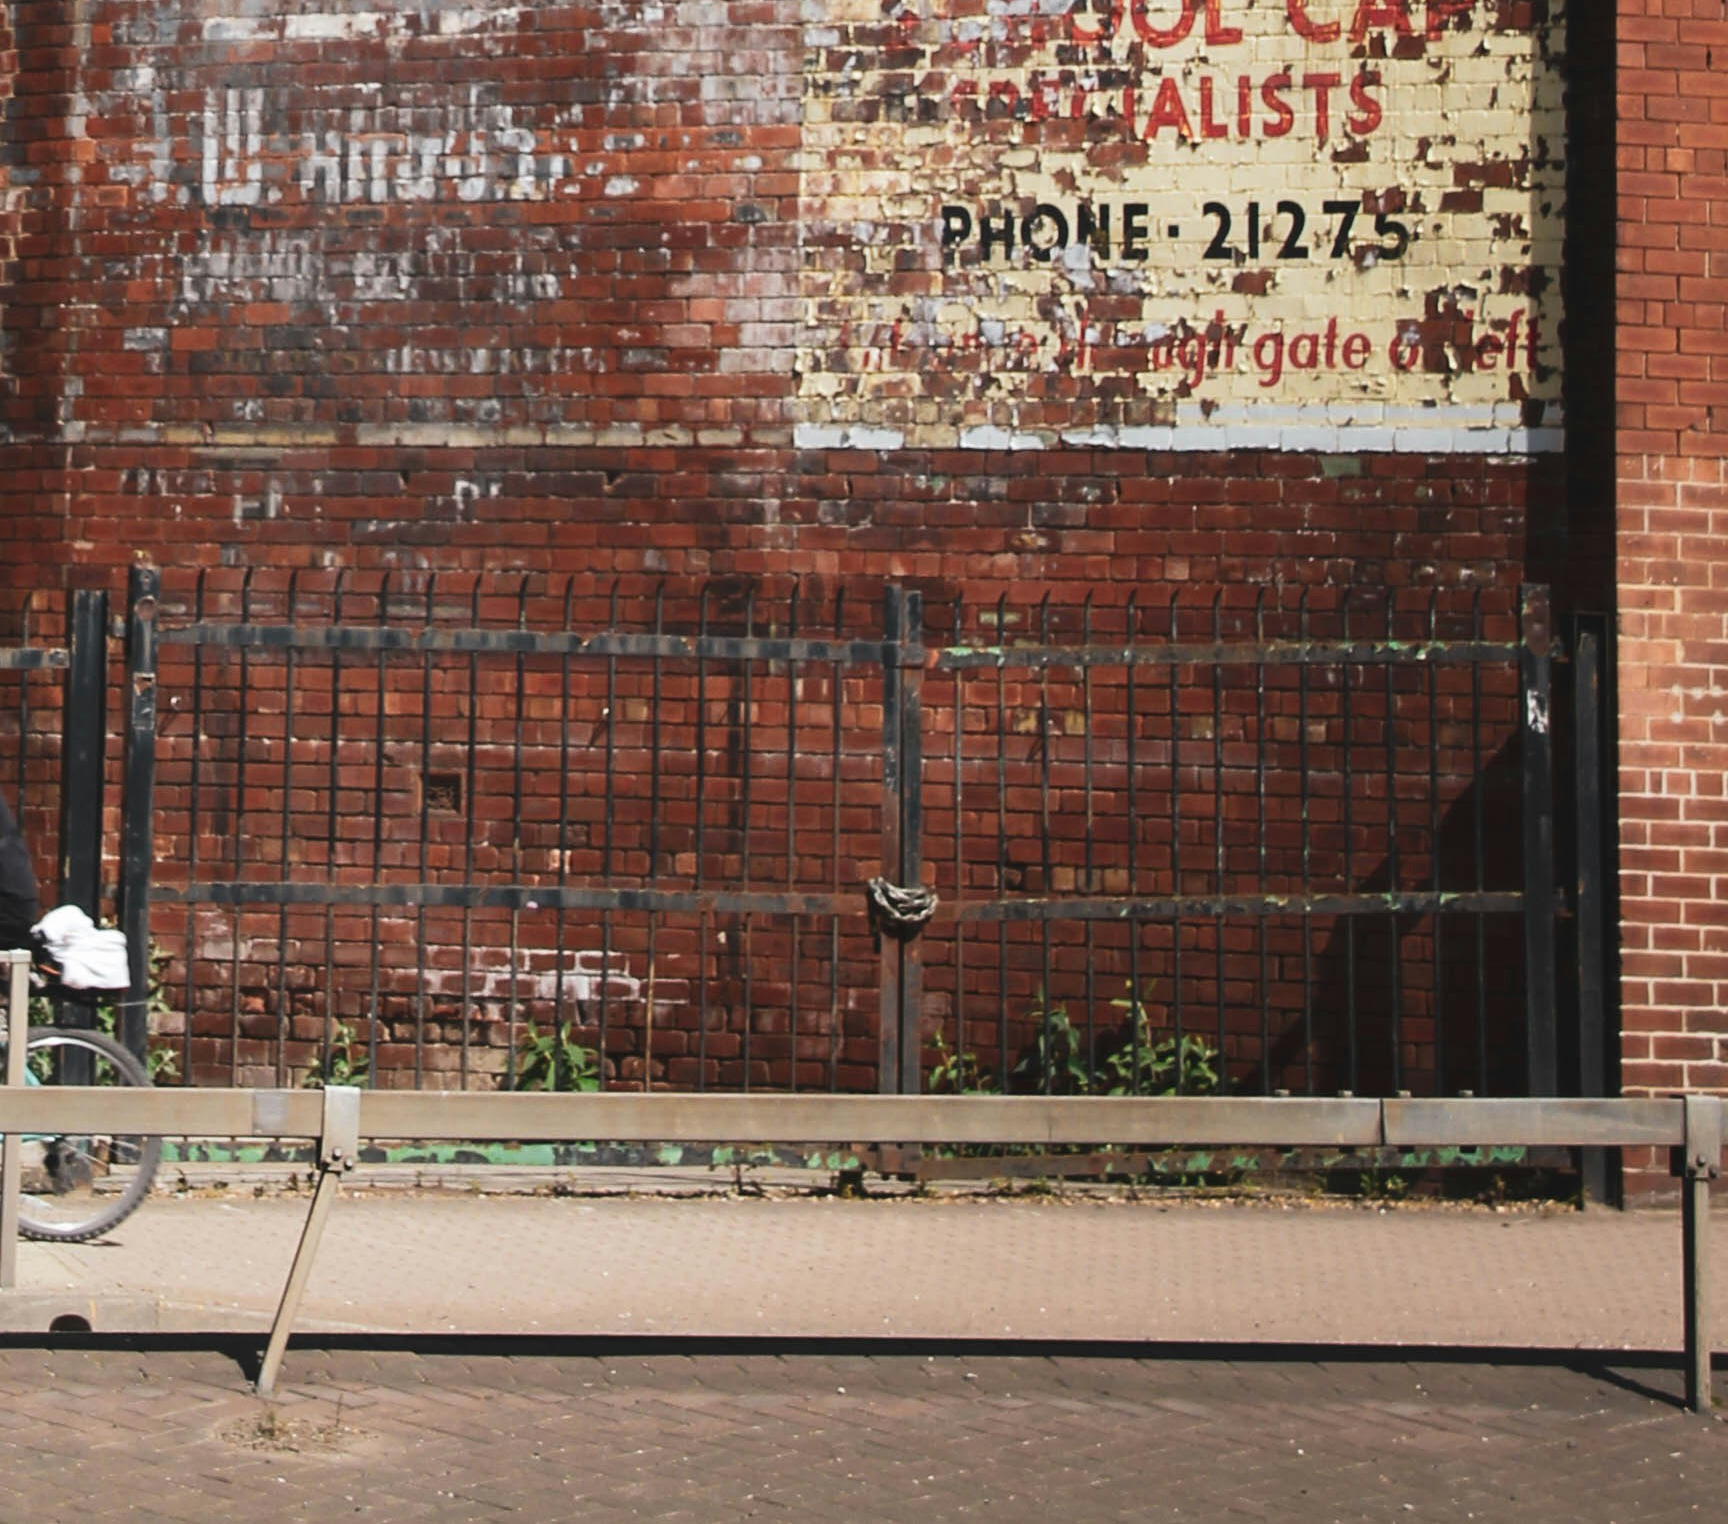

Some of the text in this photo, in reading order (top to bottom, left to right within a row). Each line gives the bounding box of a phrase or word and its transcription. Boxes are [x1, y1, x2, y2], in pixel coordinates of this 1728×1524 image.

[941, 200, 1409, 262] PHONE 21275
[1253, 316, 1372, 388] gate
[1465, 309, 1541, 372] eft
